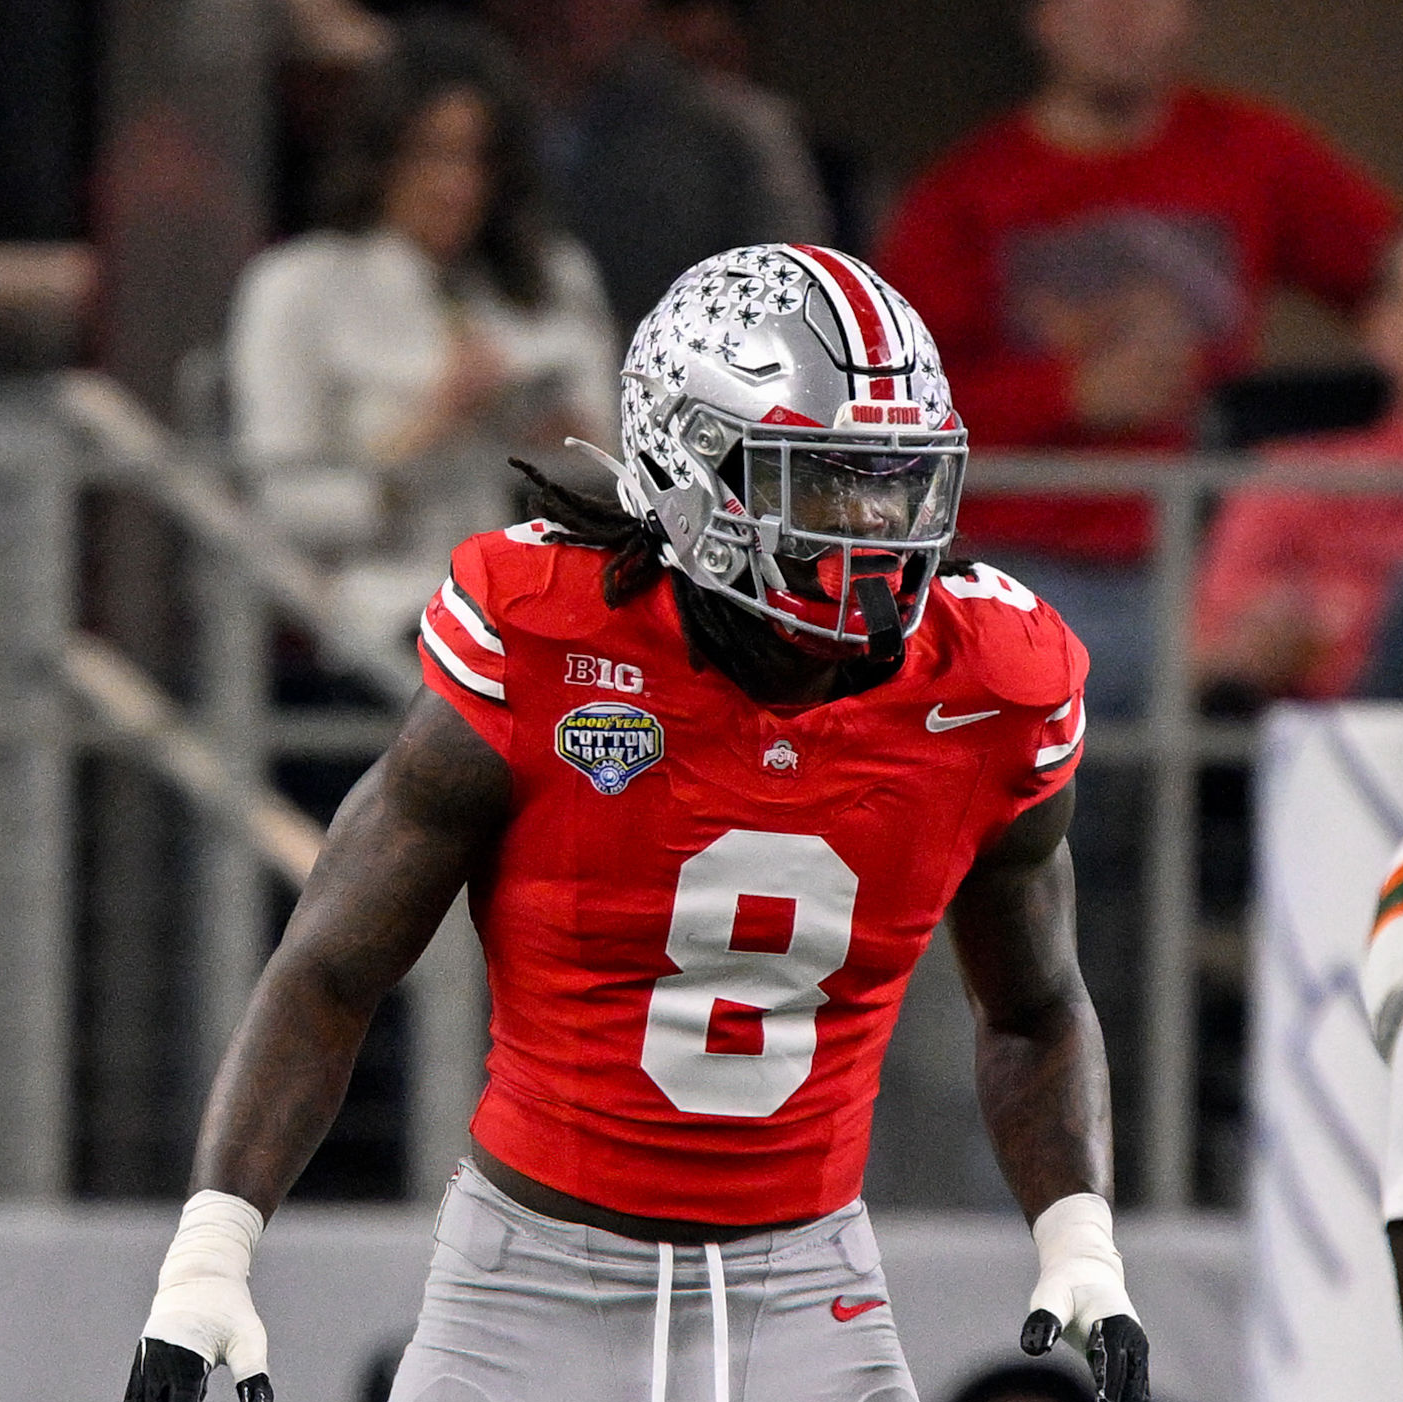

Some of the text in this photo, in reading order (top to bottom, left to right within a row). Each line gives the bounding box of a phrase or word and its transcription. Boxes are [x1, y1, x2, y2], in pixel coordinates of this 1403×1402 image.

[564, 729, 655, 758] COTTON
[582, 746, 638, 763] BOWL
[640, 829, 859, 1117] 8
